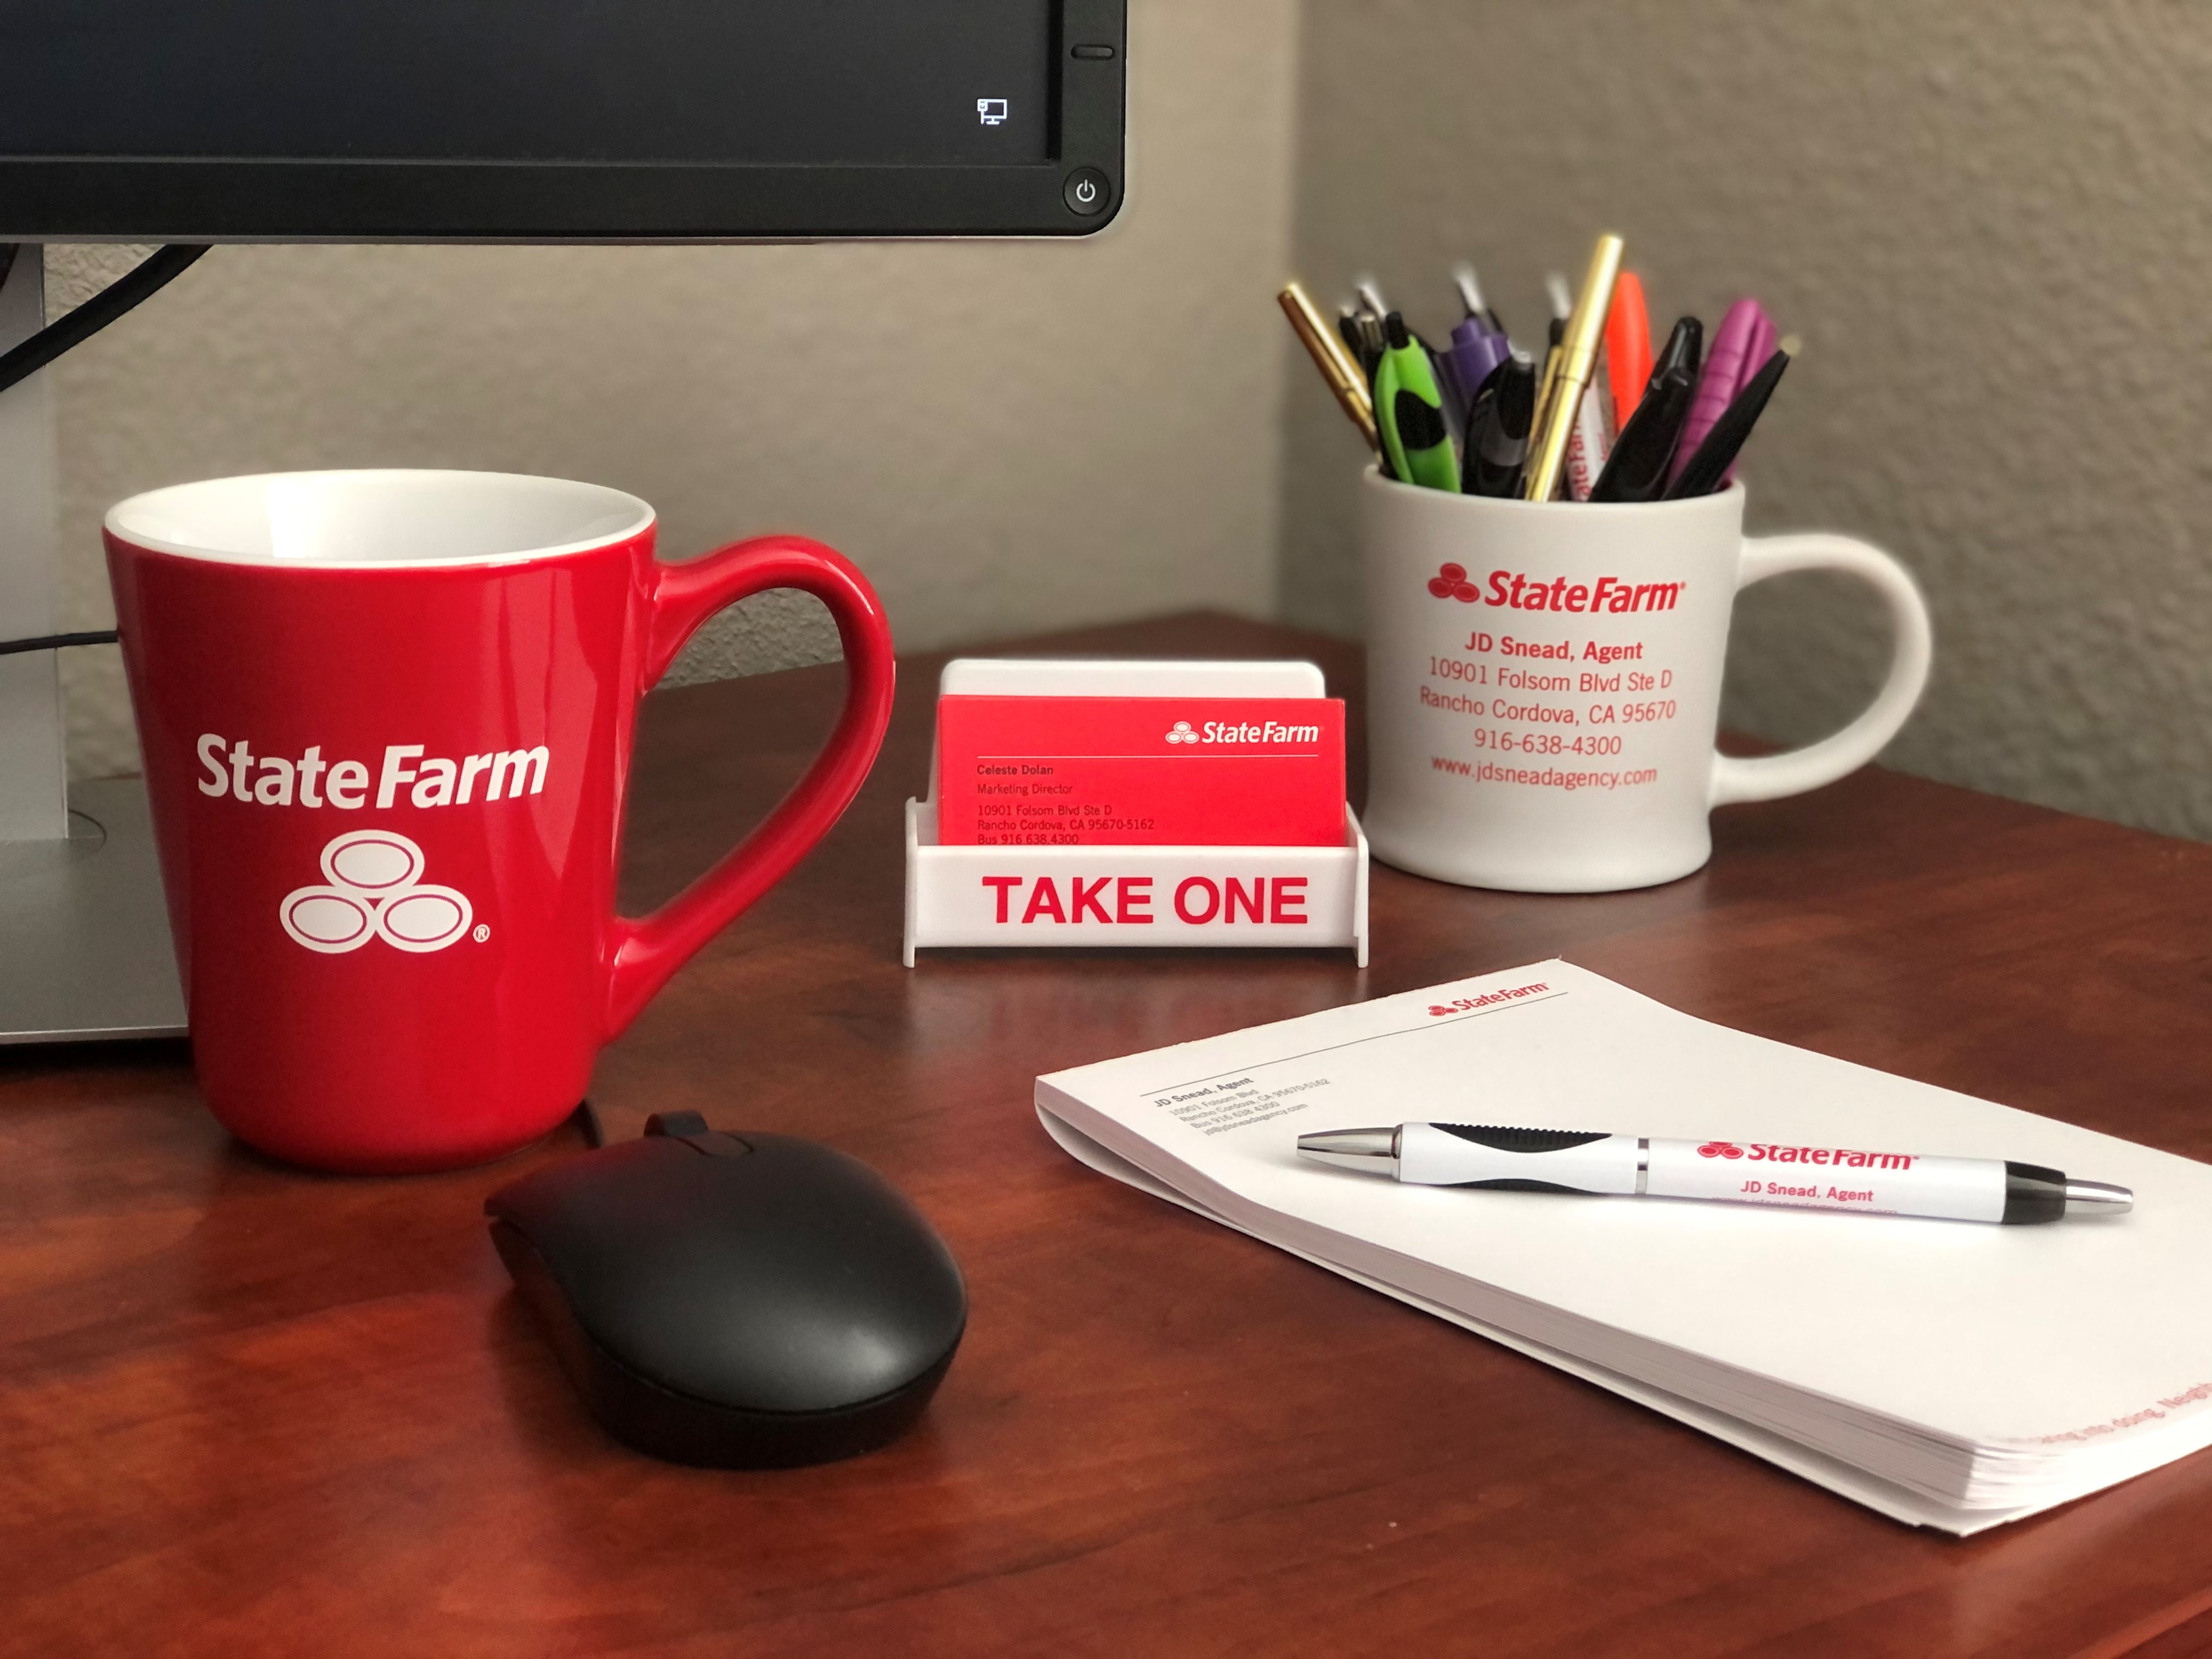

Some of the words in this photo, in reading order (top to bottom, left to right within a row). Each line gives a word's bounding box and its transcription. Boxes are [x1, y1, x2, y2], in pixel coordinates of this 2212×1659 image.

[1464, 632, 1493, 653] JD
[1500, 636, 1575, 662] Snead,
[1583, 641, 1644, 664] Agent
[1430, 656, 1487, 685] 10901
[1498, 667, 1571, 691] Folsom
[1579, 673, 1621, 692] Blvd
[1627, 672, 1655, 691] Ste
[1661, 669, 1673, 689] D
[1420, 686, 1485, 715] Rancho
[1492, 698, 1580, 726] Cordova,
[1589, 704, 1615, 724] CA
[1622, 699, 1677, 723] 95670
[1474, 728, 1622, 756] 916-638-4300
[197, 733, 369, 809] State
[375, 744, 550, 809] Farm
[977, 764, 1018, 775] Celeste
[1021, 764, 1054, 775] Dolan
[1431, 755, 1658, 790] www.jdsneadagency.com
[977, 783, 1029, 796] Marketing
[1032, 783, 1073, 794] Director
[978, 804, 1012, 816] 10901
[1016, 804, 1054, 816] Folsom
[1058, 804, 1080, 816] Blvd
[1084, 804, 1101, 816] Ste
[1104, 804, 1112, 816] D
[977, 819, 1017, 831] Rancho
[1019, 819, 1066, 832] Cordova,
[1069, 819, 1085, 831] CA
[1088, 819, 1155, 831] 95670-5162
[977, 833, 998, 845] Bus
[981, 876, 1154, 924] TAKE
[1173, 876, 1308, 926] ONE
[1154, 1098, 1172, 1108] JD
[1171, 1088, 1217, 1102] Snead,
[1216, 1077, 1255, 1091] Agent
[1169, 1104, 1203, 1116] 10901
[1201, 1096, 1237, 1107] Folsom
[1235, 1089, 1260, 1098] Blvd
[1179, 1110, 1217, 1122] Rancho
[1740, 1181, 1762, 1194] JD
[1767, 1182, 1821, 1199] Snead,
[1827, 1186, 1874, 1202] Agent
